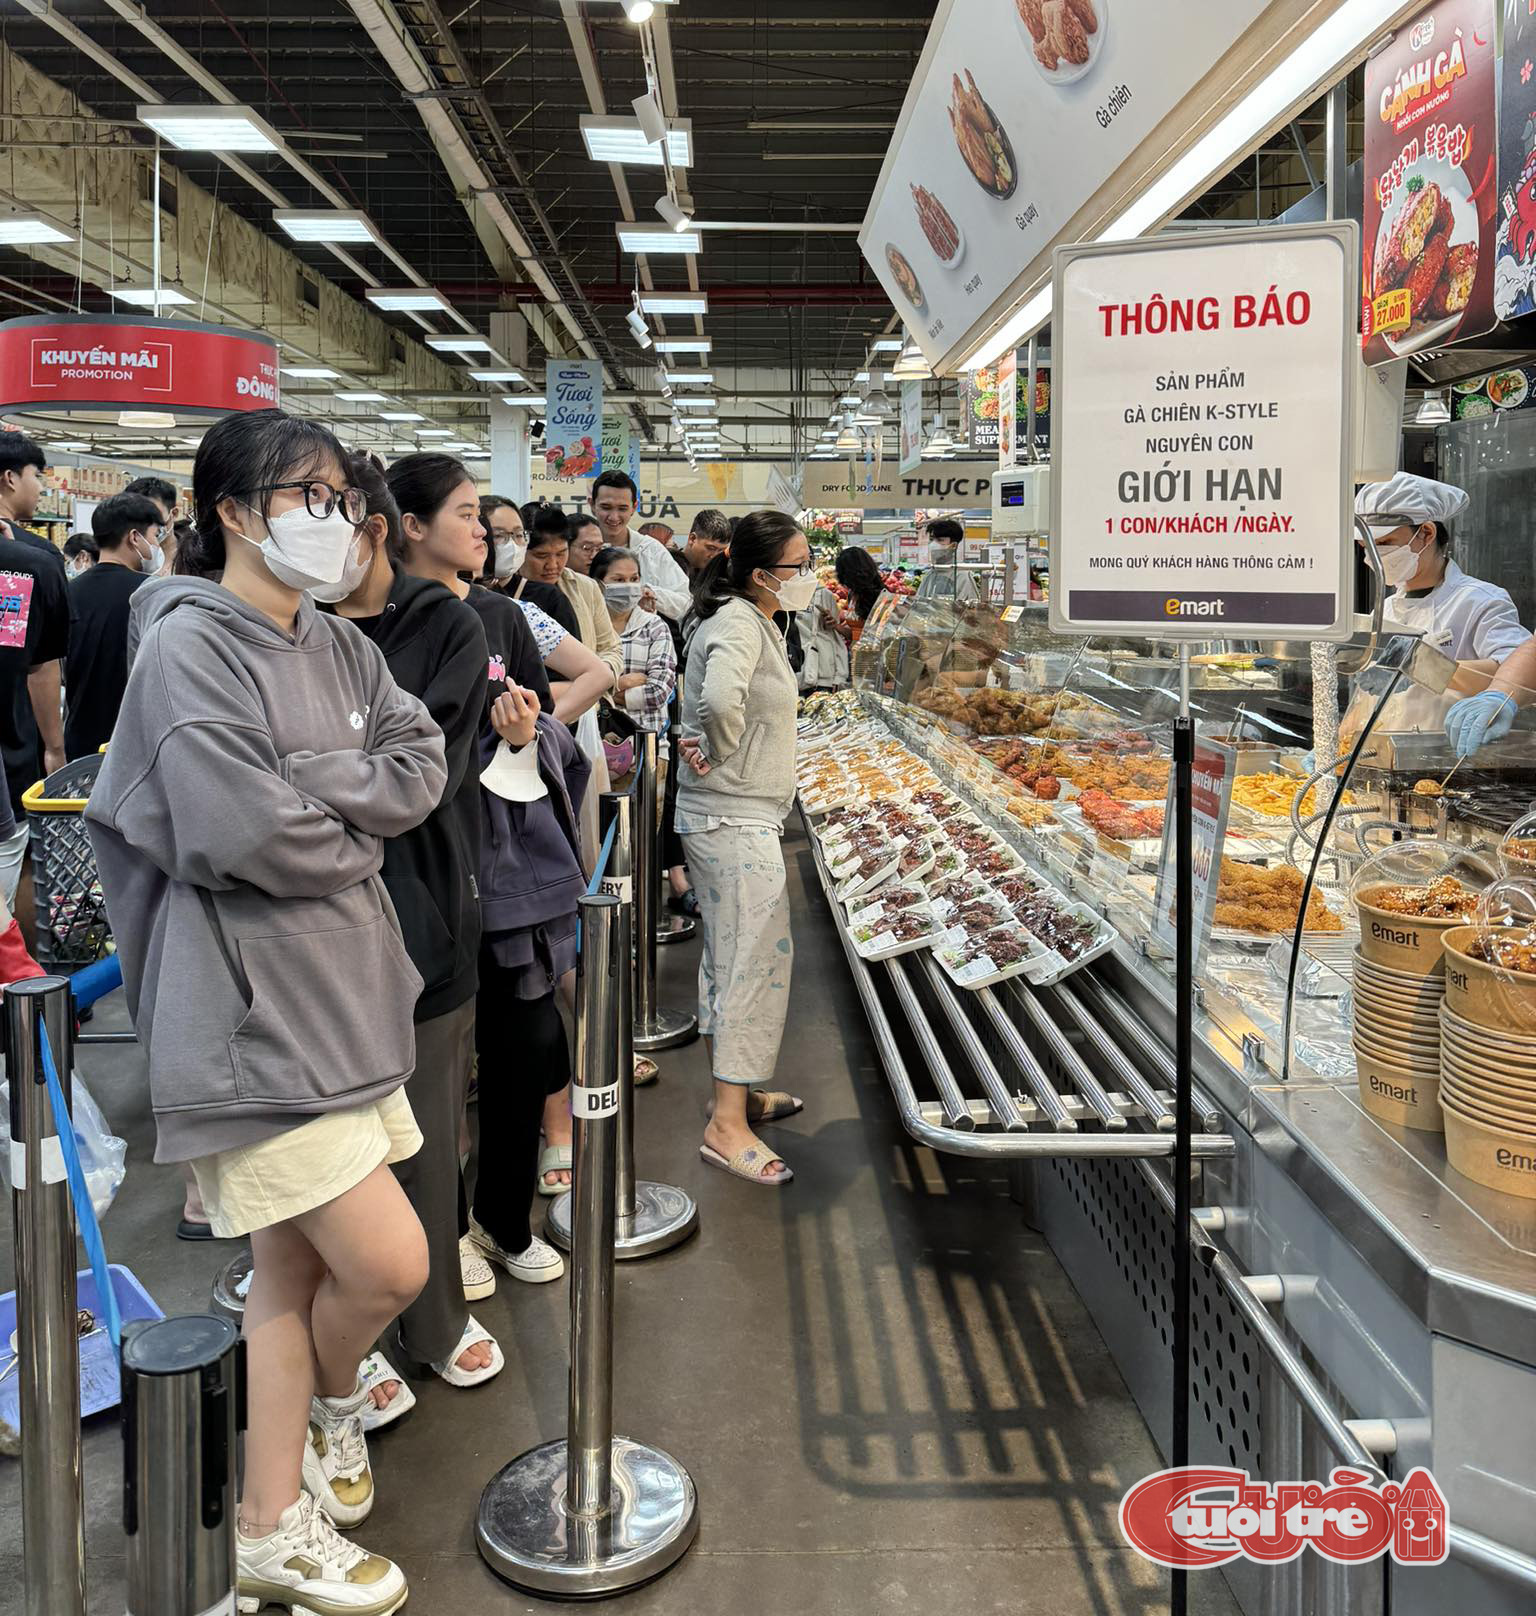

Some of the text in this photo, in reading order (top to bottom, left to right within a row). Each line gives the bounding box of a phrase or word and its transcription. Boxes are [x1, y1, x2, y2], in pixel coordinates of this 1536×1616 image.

[1380, 27, 1467, 122] CÁNH GÀ
[1096, 84, 1132, 128] Gà chiên
[1380, 123, 1467, 211] 닭날개 볶음밥
[1099, 284, 1311, 337] THÔNG BÁO
[1376, 302, 1406, 327] 27.000
[41, 345, 158, 369] KHUYẾN MÃI
[61, 368, 133, 381] PROMOTION
[1155, 366, 1245, 392] SẢN PHẨM
[236, 375, 274, 401] ĐÔNG
[556, 382, 594, 402] Tươi
[551, 406, 598, 431] Sống
[1124, 402, 1279, 424] GÀ CHIÊN K-STYLE
[975, 425, 999, 435] MEA
[1146, 433, 1253, 454] NGUYÊN CON
[822, 484, 839, 492] DRY
[901, 477, 992, 501] THỰC P
[1118, 460, 1283, 511] GIỚI HẠN
[1105, 512, 1295, 534] 1 CON/KHÁCH /NGÀY.
[1089, 554, 1314, 569] MONG QUÝ KHÁCH HÀNG THÔNG CẢM !
[1165, 598, 1225, 616] emart
[1191, 768, 1212, 793] HUYẾN
[600, 882, 624, 896] ERY
[1371, 922, 1420, 948] emart
[1445, 967, 1468, 991] mart
[588, 1090, 617, 1111] DEL
[1369, 1075, 1418, 1103] emart
[1496, 1148, 1536, 1174] ema
